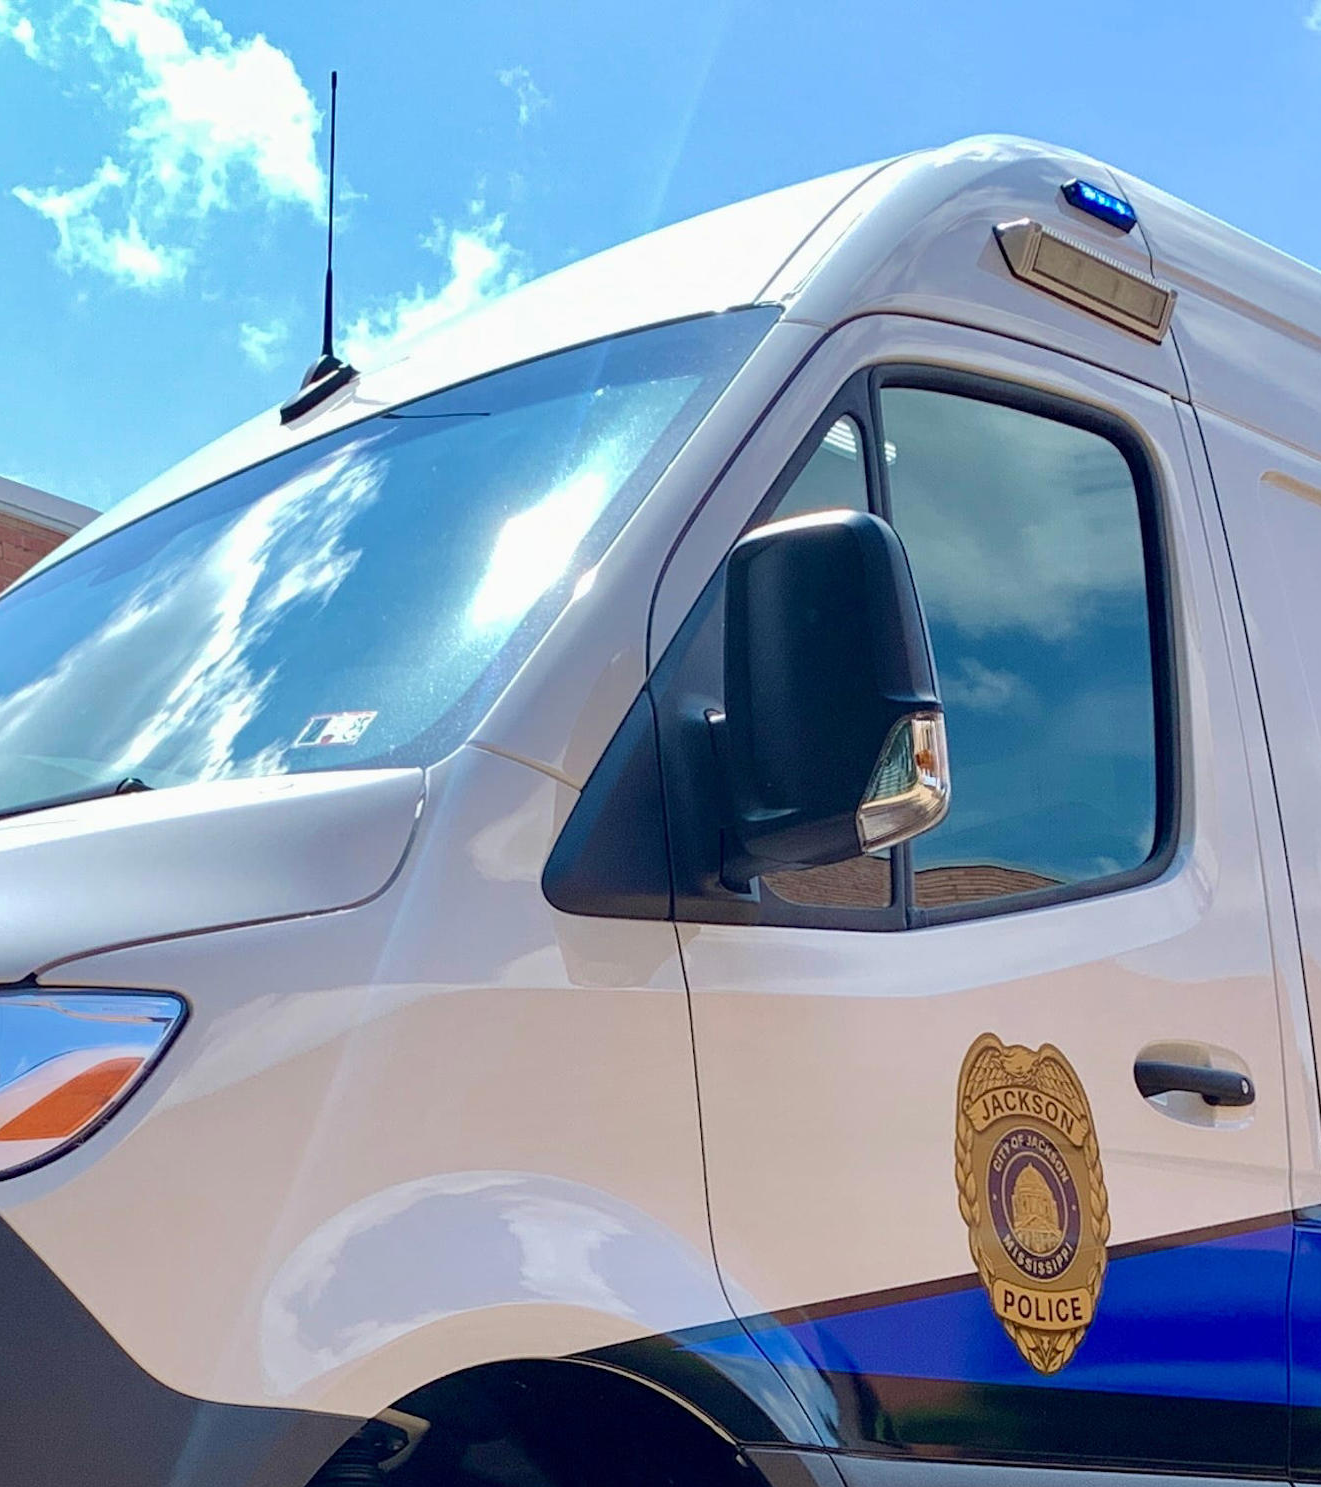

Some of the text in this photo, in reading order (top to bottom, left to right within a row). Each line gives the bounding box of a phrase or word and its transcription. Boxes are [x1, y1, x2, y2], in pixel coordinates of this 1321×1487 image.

[981, 1090, 1075, 1135] JACKSON
[992, 1134, 1070, 1185] CITY OF JACKSON
[1002, 1233, 1074, 1276] MISSISSIPPI
[1003, 1289, 1083, 1323] POLICE
